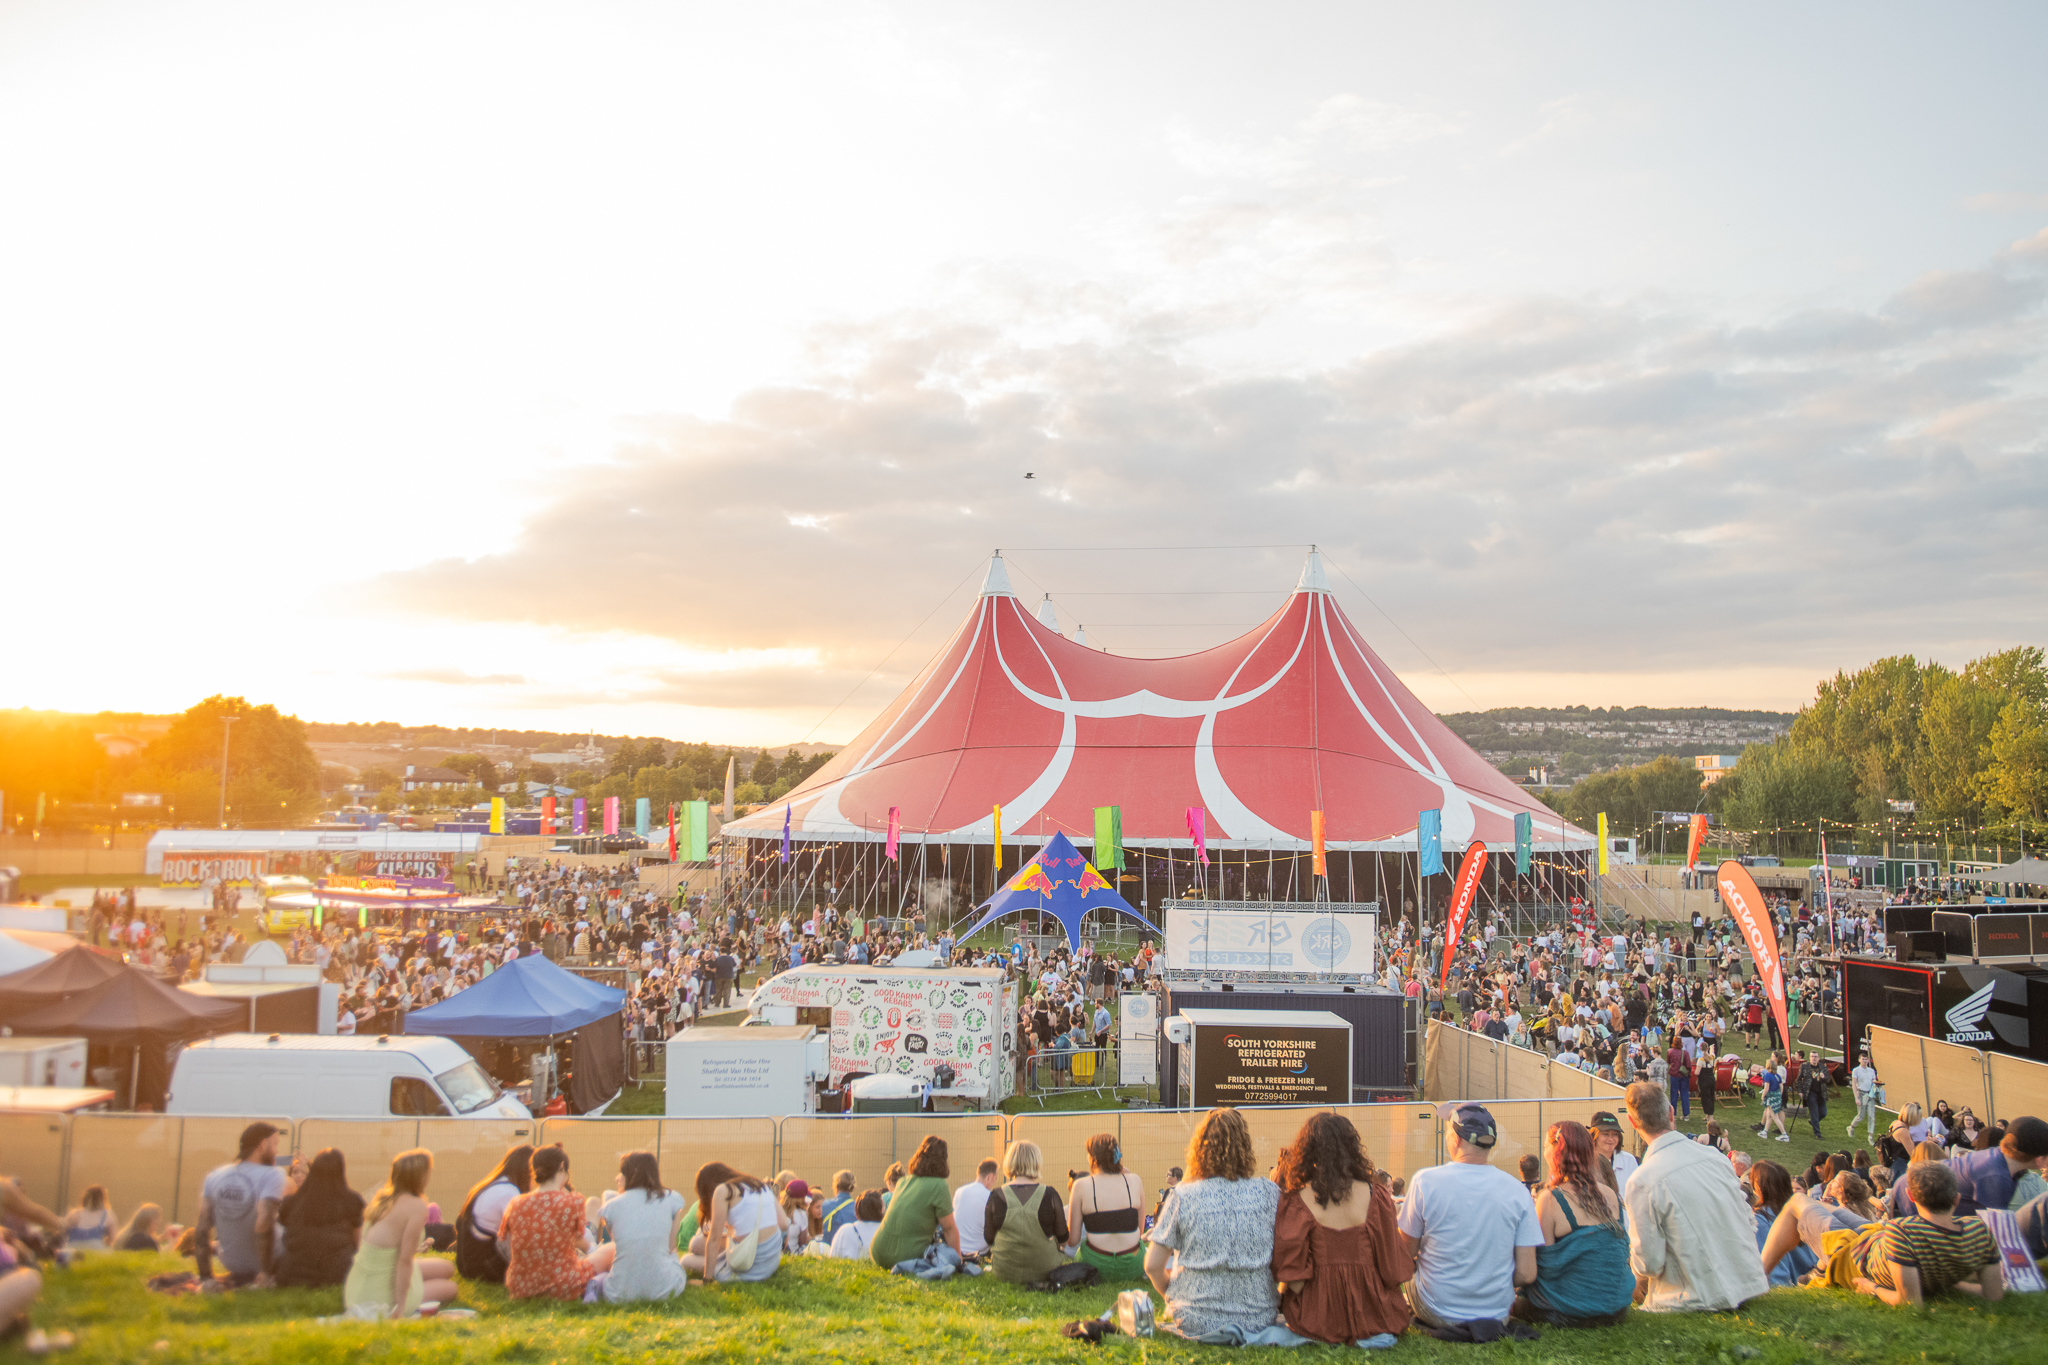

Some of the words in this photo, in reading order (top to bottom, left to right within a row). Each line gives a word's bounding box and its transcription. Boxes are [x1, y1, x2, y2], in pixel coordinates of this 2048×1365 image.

[375, 851, 403, 860] ROCK
[415, 852, 443, 860] ROLL
[1038, 853, 1061, 868] Bull
[1065, 851, 1086, 868] Red
[164, 859, 211, 881] ROCK
[221, 859, 266, 880] ROLL
[366, 878, 396, 891] SWEETS
[1454, 849, 1484, 925] HONDA
[1988, 932, 2019, 940] HONDA
[771, 986, 791, 995] GOOD
[874, 989, 894, 998] GOOD
[896, 991, 923, 1000] KARMA
[977, 991, 993, 1000] GOO
[884, 997, 913, 1007] KEBABS
[1945, 1031, 1994, 1042] HONDA
[1227, 1039, 1261, 1048] SOUTH
[1263, 1039, 1317, 1049] YORKSHIRE
[1238, 1049, 1306, 1058] REFRIGERATED
[831, 1056, 840, 1064] OD
[842, 1057, 869, 1068] KARMA
[923, 1058, 944, 1066] GOOD
[945, 1060, 973, 1070] KARMA
[1241, 1058, 1278, 1067] TRAILER
[1280, 1059, 1303, 1068] HIRE
[1228, 1076, 1255, 1084] FRIDGE
[1256, 1076, 1263, 1084] &
[1297, 1077, 1315, 1085] HIRE
[1244, 1092, 1298, 1101] 07725994017
